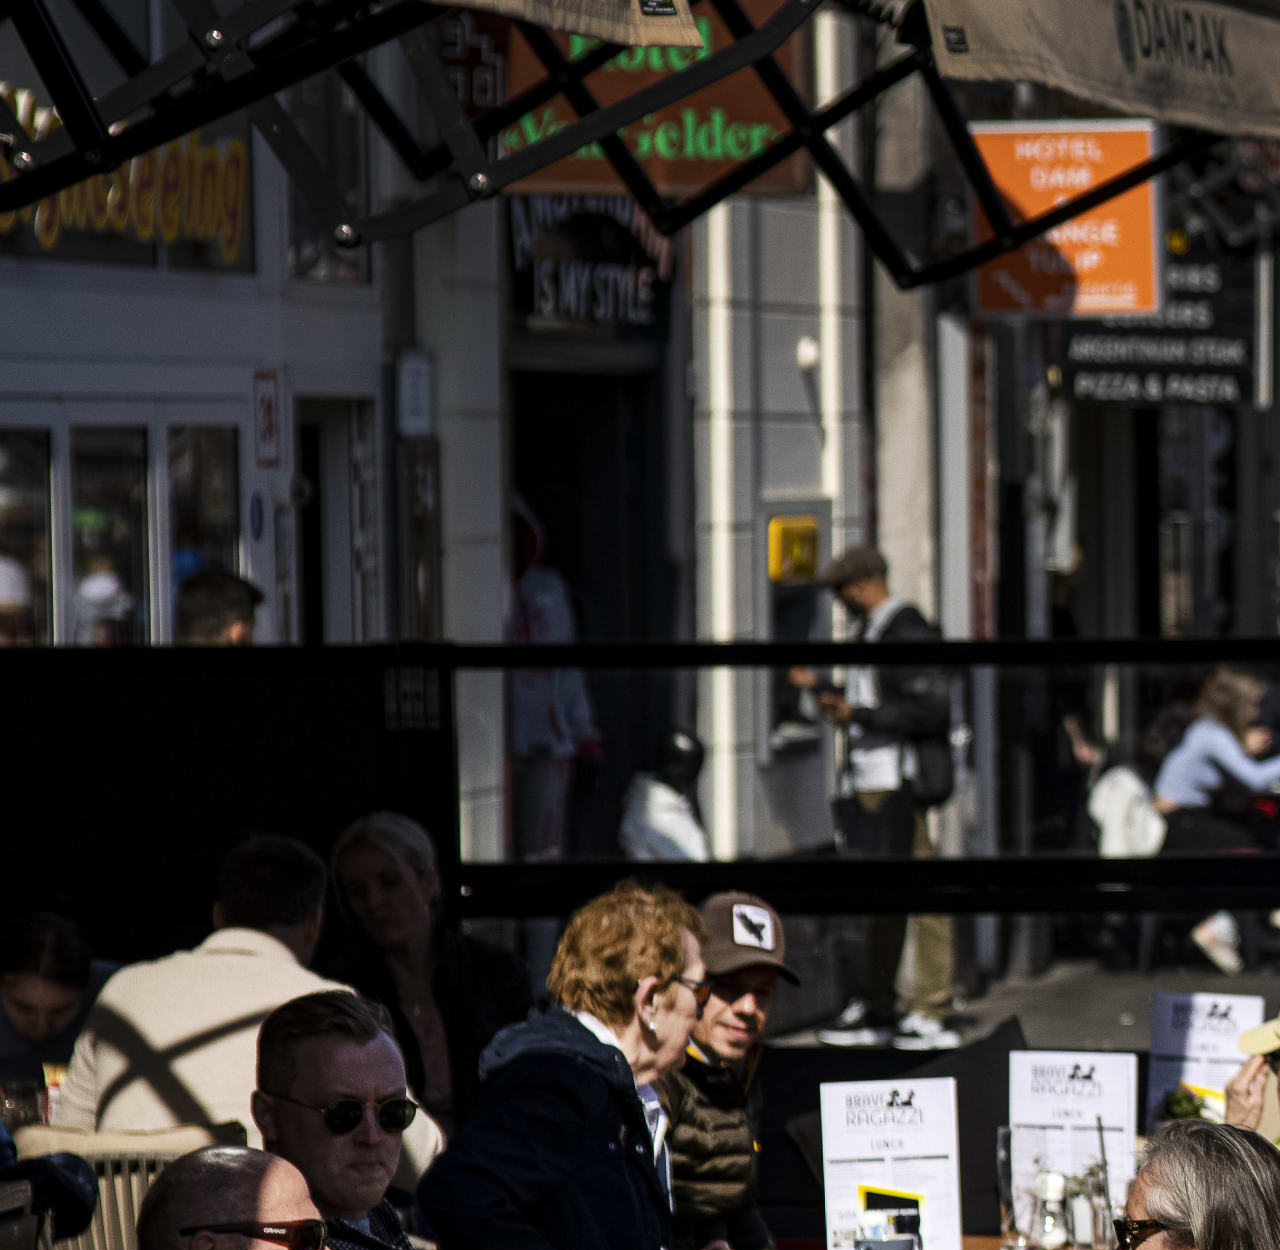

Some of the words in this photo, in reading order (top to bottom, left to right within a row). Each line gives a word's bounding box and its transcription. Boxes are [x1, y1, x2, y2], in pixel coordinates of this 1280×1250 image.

[1132, 0, 1234, 76] DAMRAK
[1014, 136, 1104, 163] HOTEL
[1030, 165, 1093, 192] DAM
[559, 261, 590, 319] MY
[593, 263, 656, 324] STYLE
[1074, 370, 1142, 400] PIZZA
[1165, 373, 1240, 402] PASTA
[1031, 1064, 1066, 1078] BRAVI
[845, 1093, 883, 1109] BRAVI
[1031, 1078, 1103, 1097] RAGAZZI
[845, 1108, 924, 1127] RAGAZZI
